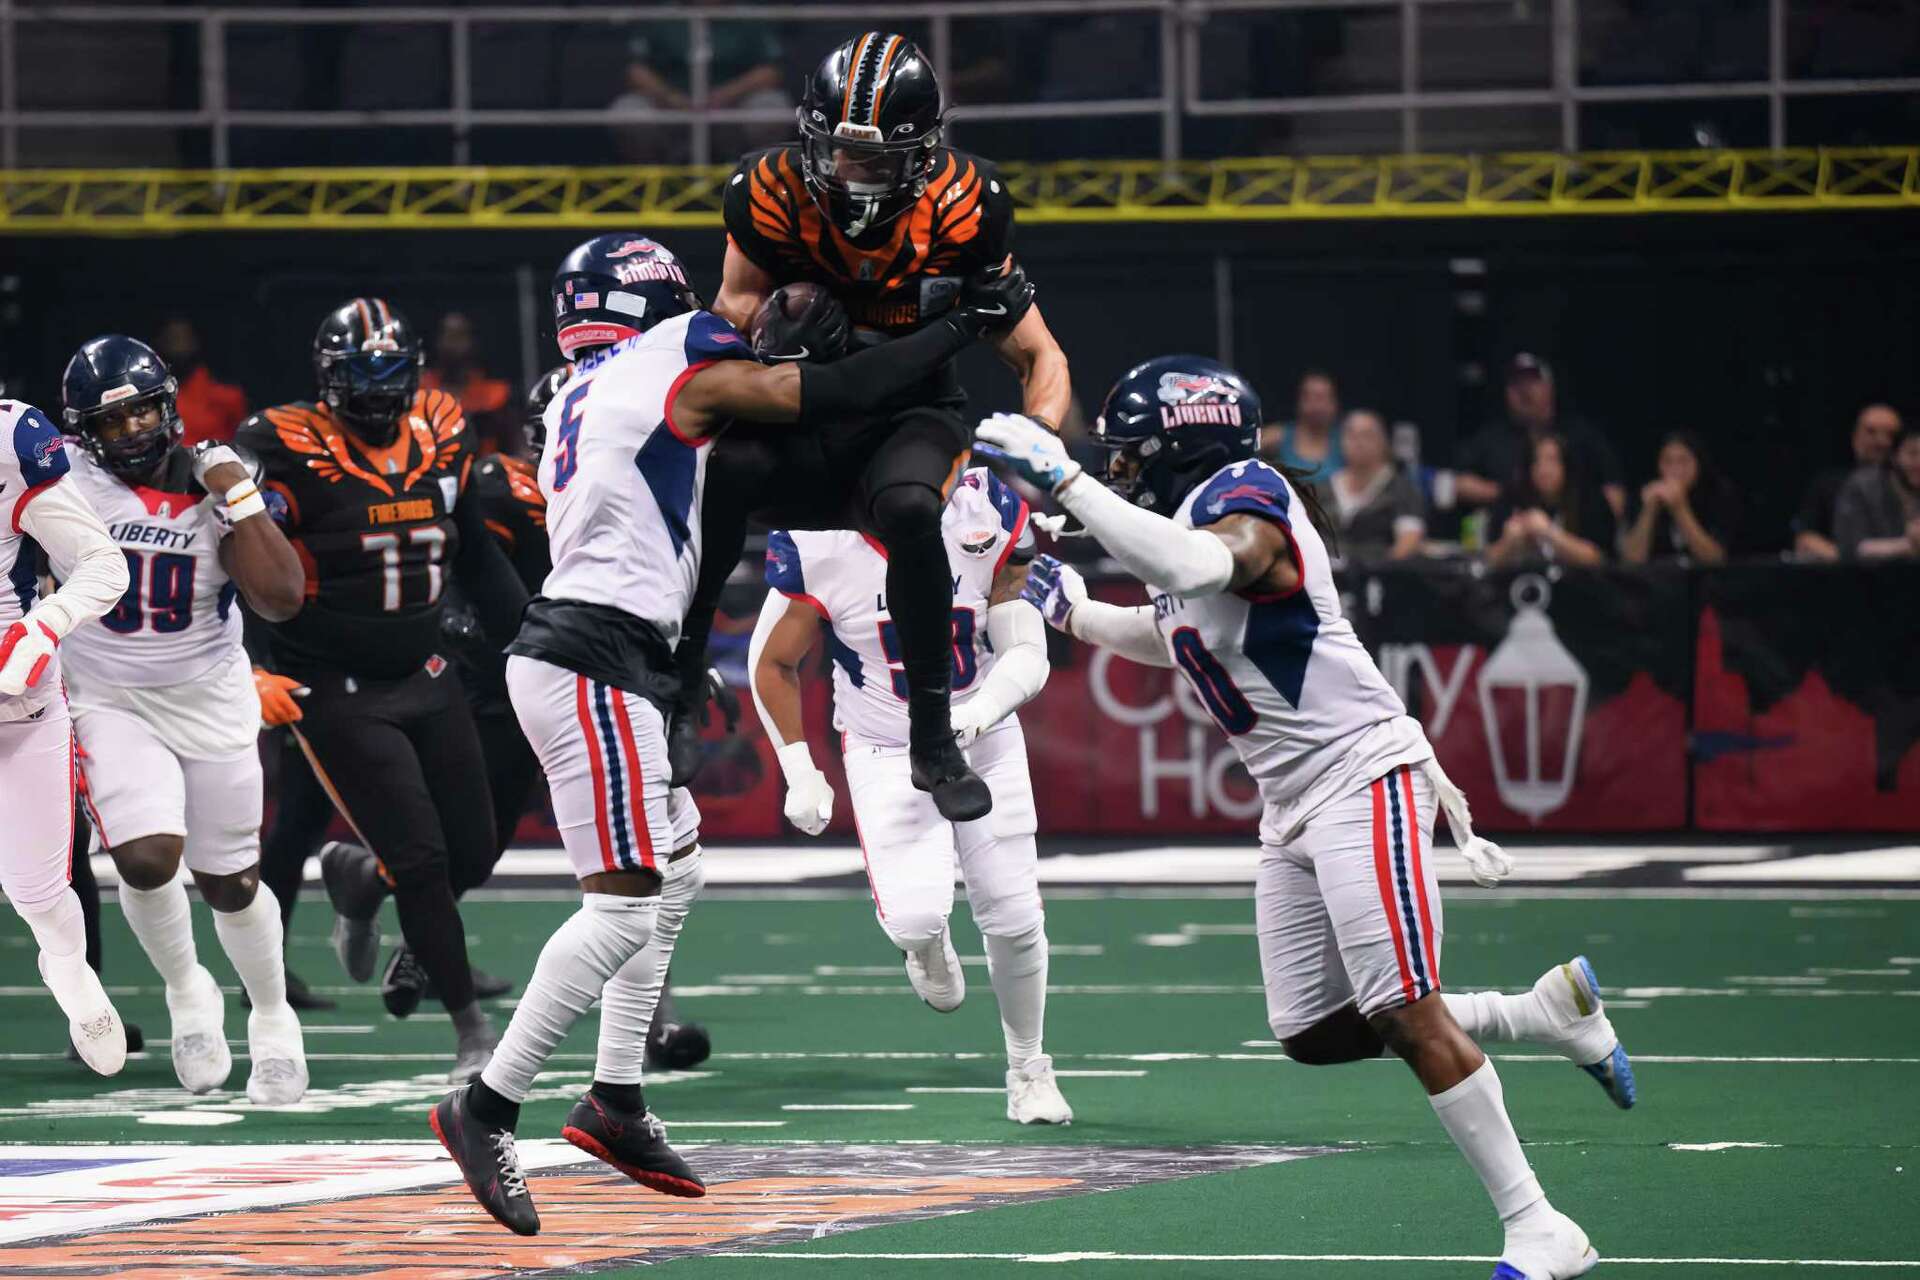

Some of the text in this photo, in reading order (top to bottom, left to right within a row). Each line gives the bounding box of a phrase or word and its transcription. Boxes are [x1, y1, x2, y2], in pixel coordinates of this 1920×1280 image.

[553, 378, 594, 492] 5
[1159, 403, 1242, 430] LIBERTY
[109, 523, 196, 549] LIBERTY
[360, 525, 446, 611] 77
[1171, 624, 1260, 736] 0
